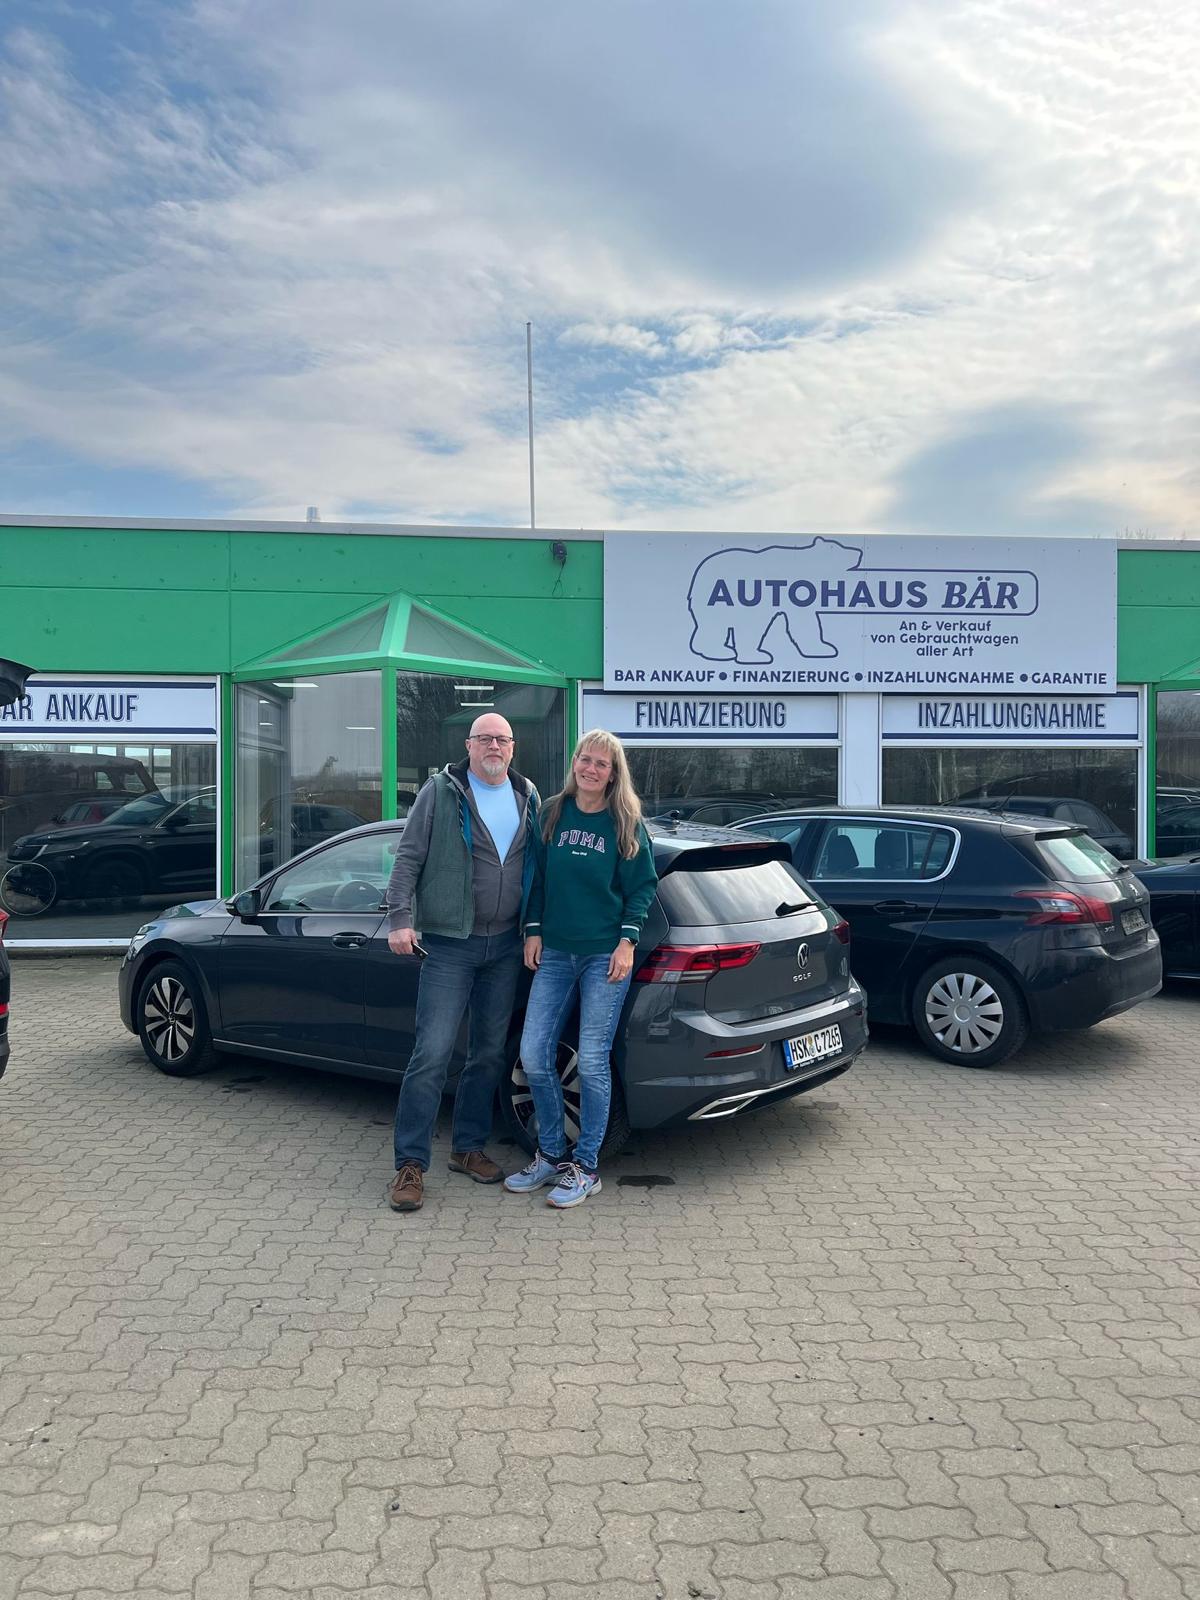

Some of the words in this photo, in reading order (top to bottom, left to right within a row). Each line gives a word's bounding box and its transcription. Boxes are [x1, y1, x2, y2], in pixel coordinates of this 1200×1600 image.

[706, 579, 928, 608] AUTOHAUS
[941, 576, 1020, 609] BÄR
[899, 620, 917, 631] An
[921, 621, 932, 631] &
[935, 620, 991, 632] Verkauf
[871, 634, 895, 644] von
[900, 633, 1019, 647] Gebrauchtwagen
[916, 645, 948, 656] aller
[952, 646, 974, 657] Art
[614, 669, 645, 682] BAR
[650, 670, 716, 683] ANKAUF
[733, 671, 850, 683] FINANZIERUNG
[867, 671, 1014, 684] INZAHLUNGNAHME
[1031, 672, 1107, 685] GARANTIE
[0, 694, 33, 721] AR
[46, 693, 138, 721] ANKAUF
[635, 701, 786, 728] FINANZIERUNG
[918, 702, 1106, 728] INZAHLUNGNAHME
[557, 829, 606, 853] PUMA
[792, 972, 812, 983] GOLF
[790, 1037, 810, 1062] HSK
